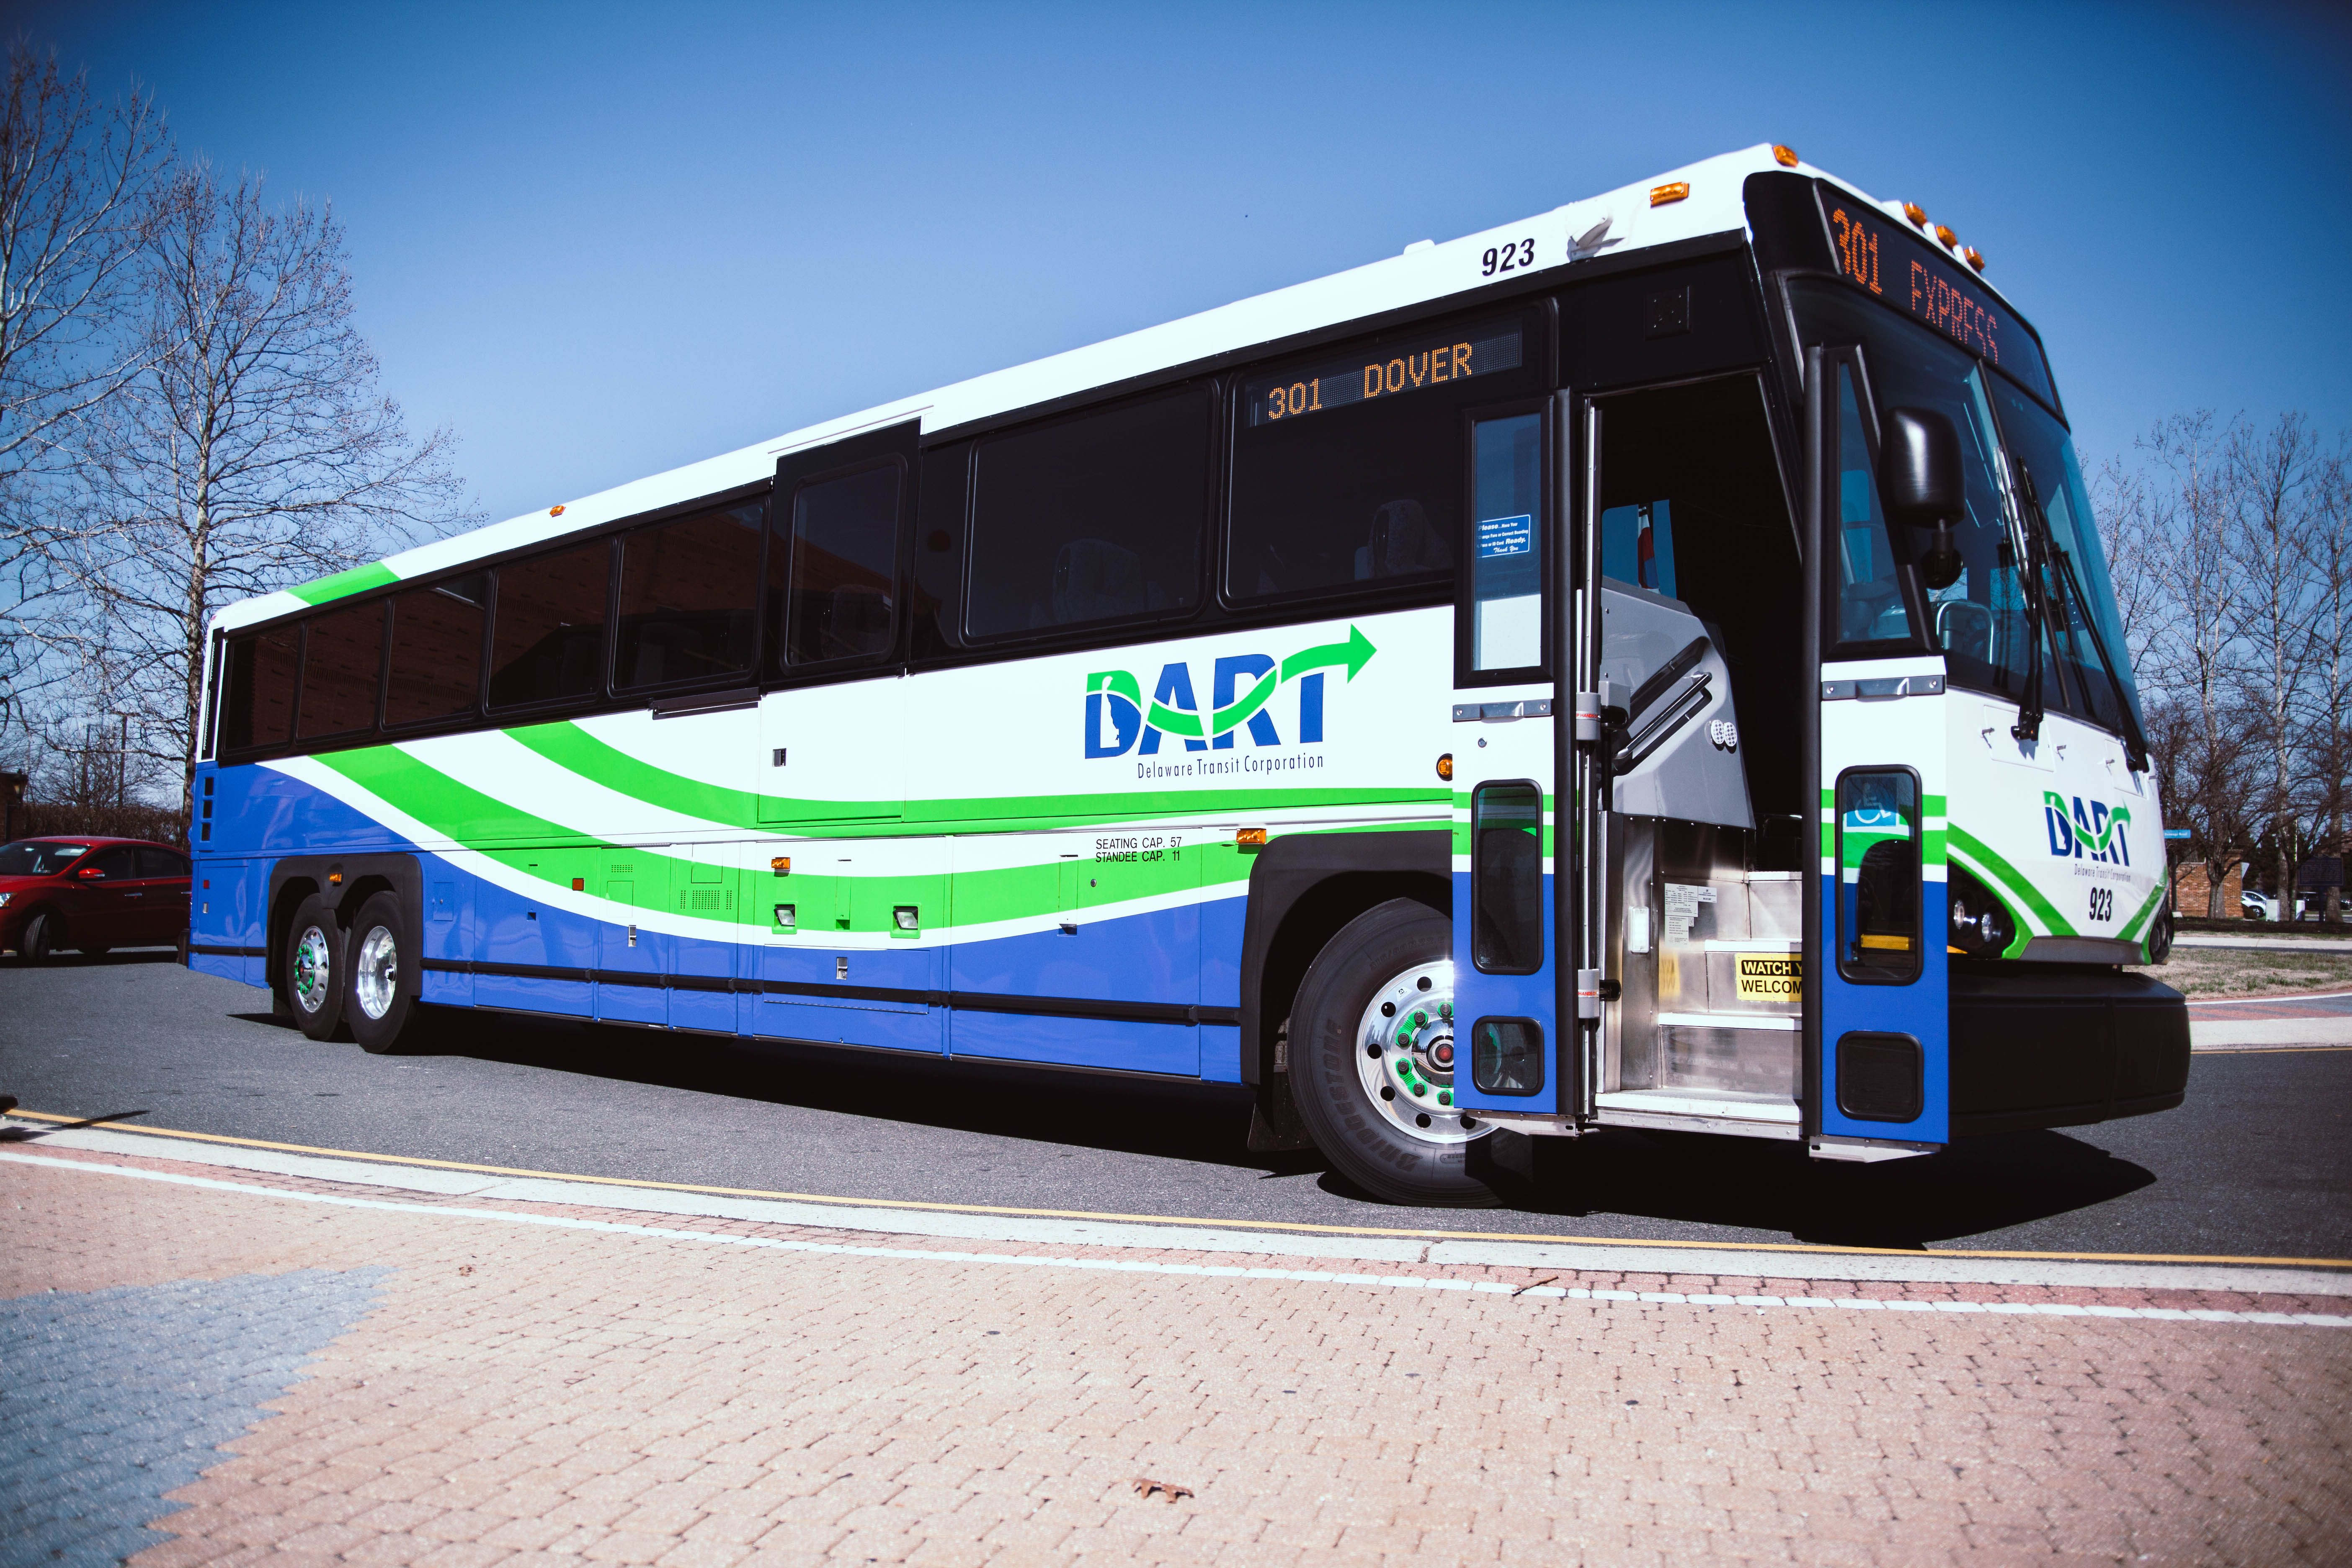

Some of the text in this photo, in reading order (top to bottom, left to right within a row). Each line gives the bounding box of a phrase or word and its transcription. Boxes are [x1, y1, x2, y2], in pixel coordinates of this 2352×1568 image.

[1482, 238, 1534, 276] 923
[1833, 208, 1882, 295] 301
[1269, 342, 1473, 420] 301 DOVER
[1085, 641, 1349, 759] DART
[1138, 753, 1323, 779] Delaware Transit Corporation
[1096, 837, 1182, 849] SEATING CAP. 57
[2043, 791, 2131, 867] DART
[1095, 850, 1180, 863] STANDEE CAP. 11
[2074, 863, 2095, 877] Delaware
[2089, 887, 2112, 922] 923
[1743, 962, 1792, 975] WATCH
[1741, 980, 1802, 994] WELCOM
[1323, 1018, 1423, 1171] BRIDGESTONE
